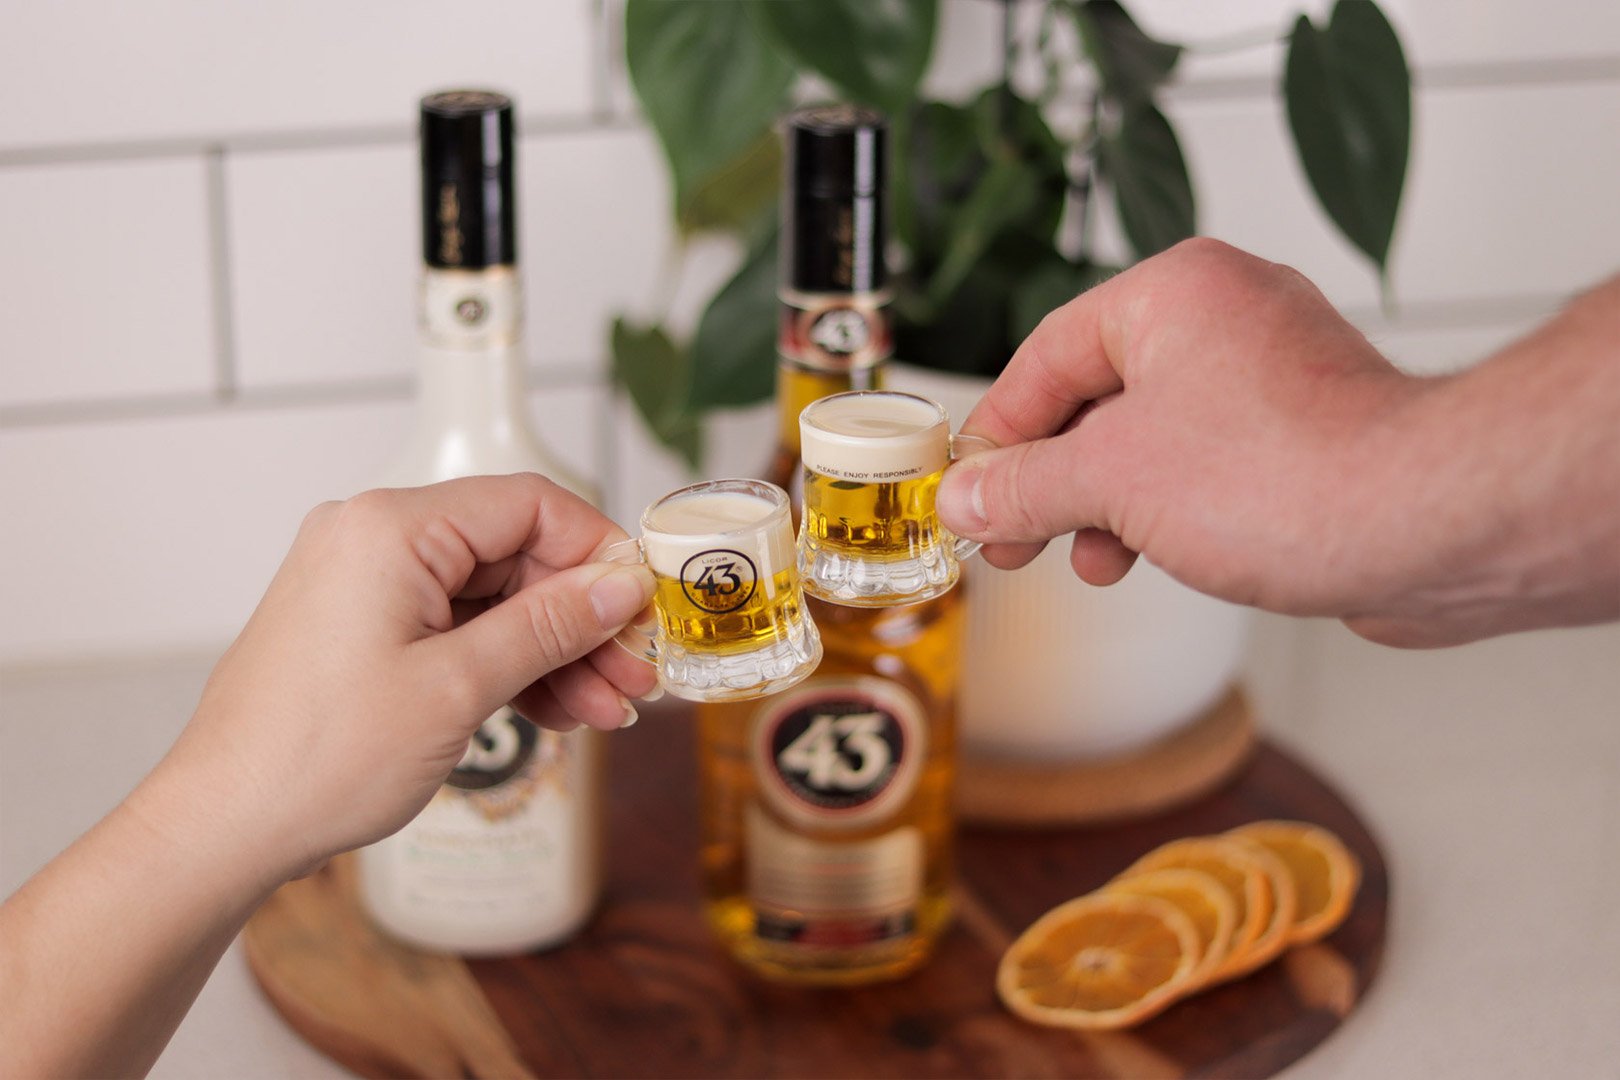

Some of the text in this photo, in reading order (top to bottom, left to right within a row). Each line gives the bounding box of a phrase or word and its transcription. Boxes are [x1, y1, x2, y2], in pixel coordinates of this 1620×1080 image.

[816, 464, 924, 479] PLEASE ENJOY RESPONSIBLY
[701, 556, 728, 564] LICOR
[693, 562, 741, 596] 43
[778, 712, 890, 789] 43
